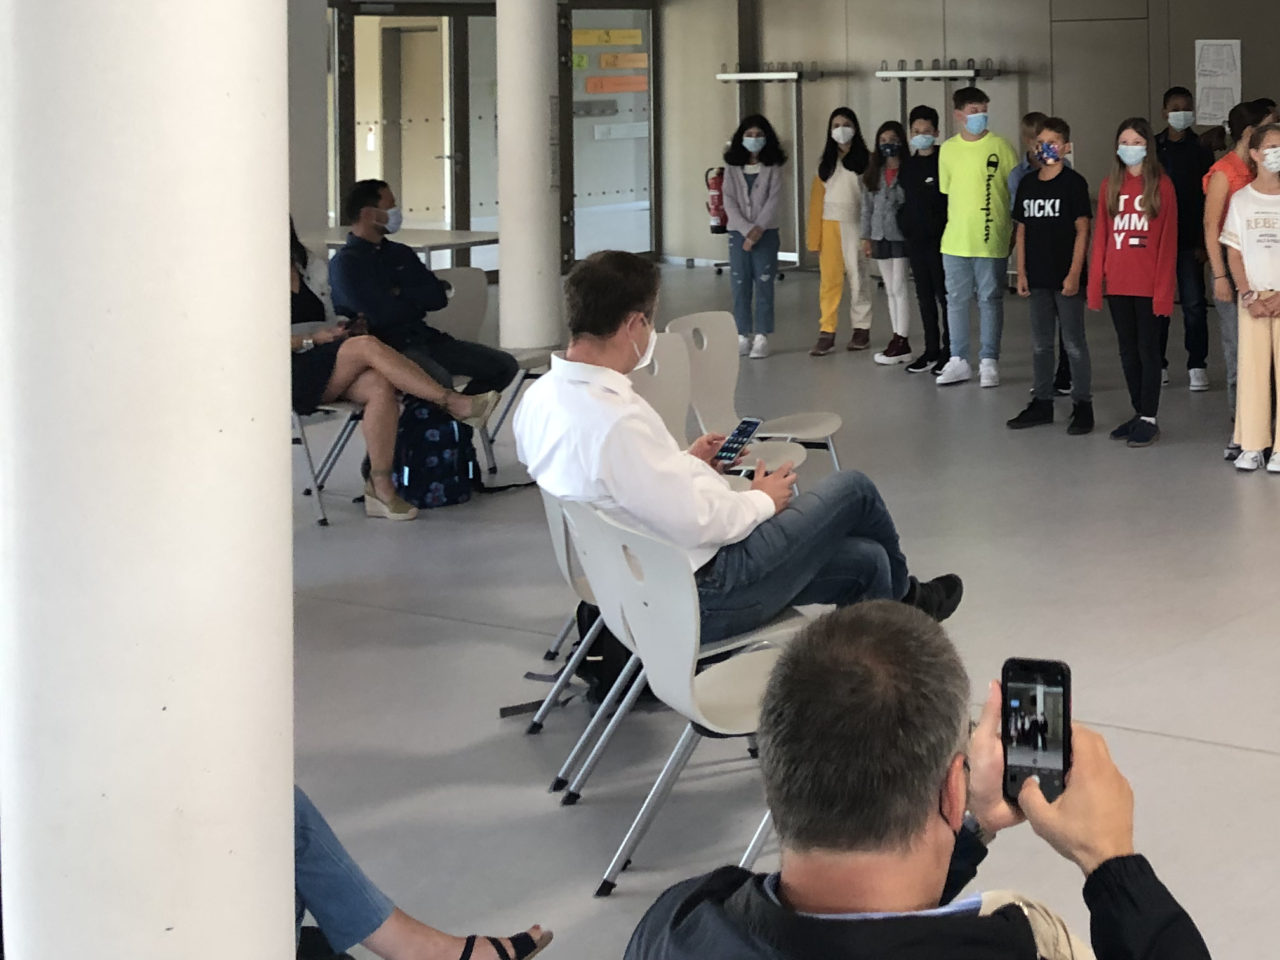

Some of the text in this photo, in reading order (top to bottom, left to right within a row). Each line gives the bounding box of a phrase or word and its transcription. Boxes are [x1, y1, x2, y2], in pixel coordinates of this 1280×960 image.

[980, 153, 999, 244] Champion
[1023, 198, 1061, 218] SICK!
[1113, 213, 1149, 231] MM
[1113, 232, 1126, 250] Y
